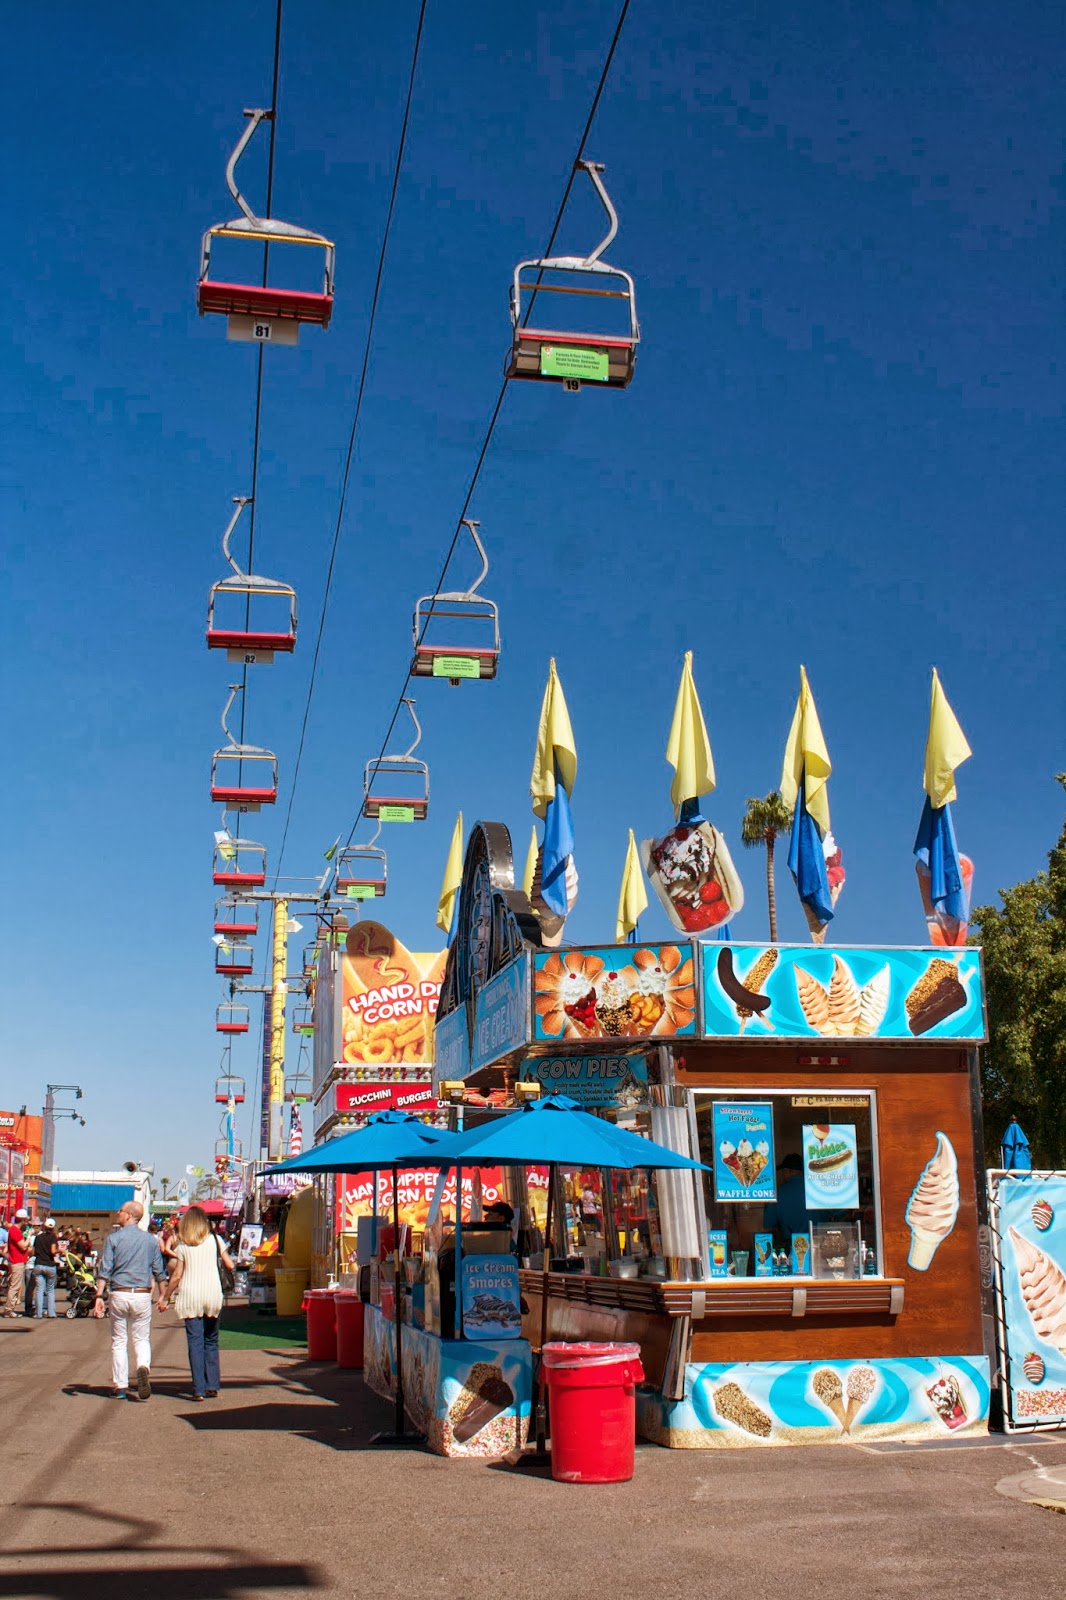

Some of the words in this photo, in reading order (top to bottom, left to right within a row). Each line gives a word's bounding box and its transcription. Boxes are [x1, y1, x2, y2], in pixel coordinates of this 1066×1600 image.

[255, 325, 270, 338] 81
[566, 380, 579, 391] 19
[245, 655, 256, 664] 82
[451, 678, 460, 686] 18
[349, 984, 414, 1012] HAND
[364, 999, 422, 1023] CORN
[538, 1058, 583, 1079] COW
[586, 1057, 629, 1078] PIES
[348, 1088, 392, 1107] ZUCCHINI
[397, 1090, 432, 1106] BURGER
[741, 1115, 760, 1123] Fudge
[808, 1141, 847, 1159] Pickles
[346, 1178, 388, 1204] HAND
[718, 1189, 750, 1198] WAFFLE
[752, 1189, 774, 1198] CONE
[465, 1263, 480, 1273] Ice
[484, 1262, 515, 1273] Cream
[469, 1276, 513, 1289] Smores
